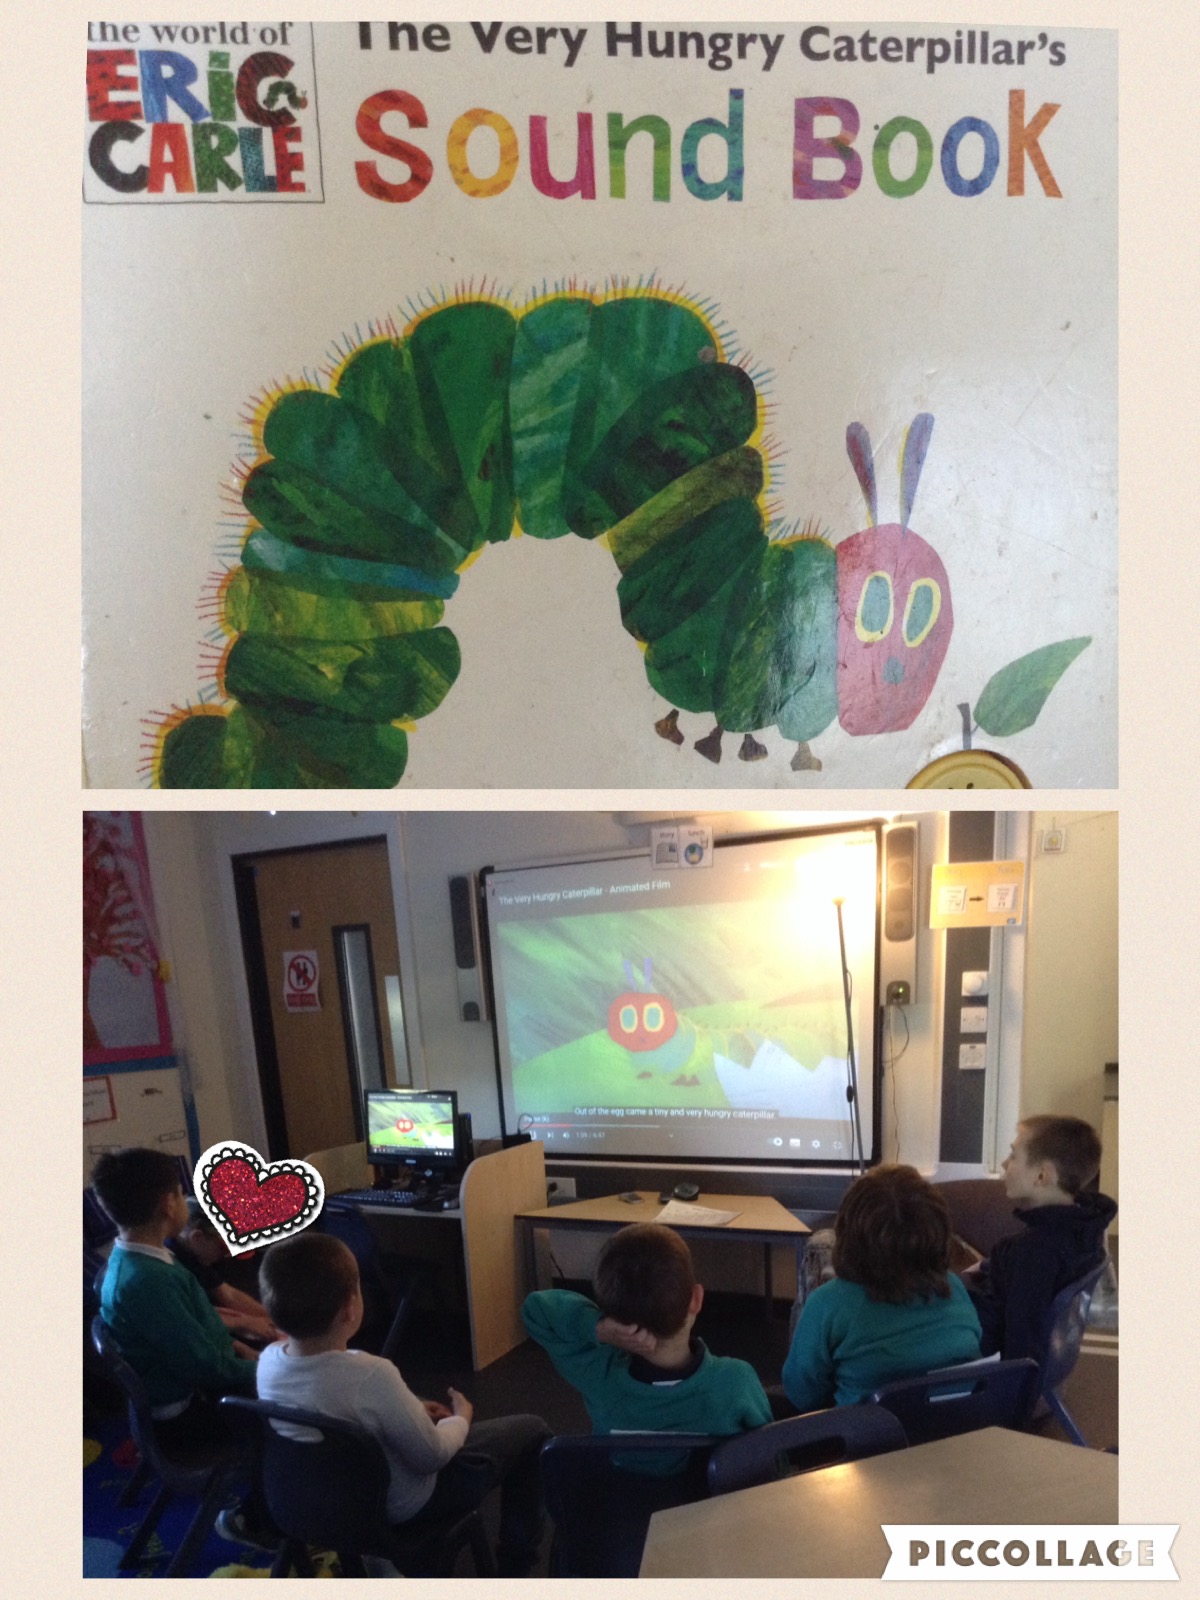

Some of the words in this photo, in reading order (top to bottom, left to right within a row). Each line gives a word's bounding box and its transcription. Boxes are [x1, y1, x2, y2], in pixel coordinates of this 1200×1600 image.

[87, 21, 140, 43] the
[151, 21, 250, 45] world
[259, 21, 294, 46] of
[469, 21, 588, 68] Very
[604, 22, 785, 72] Hungry
[87, 119, 306, 194] CARLE
[355, 89, 745, 203] Sound
[499, 896, 513, 905] The
[514, 895, 531, 905] Very
[532, 892, 561, 903] Hungry
[562, 887, 603, 899] Caterpillar
[609, 882, 650, 894] Animated
[652, 880, 671, 890] Film
[575, 1107, 587, 1116] Out
[588, 1107, 597, 1116] of
[597, 1107, 609, 1116] the
[610, 1108, 624, 1118] egg
[654, 1108, 669, 1118] tiny
[670, 1108, 684, 1117] and
[686, 1109, 702, 1118] very
[704, 1109, 731, 1120] hungry
